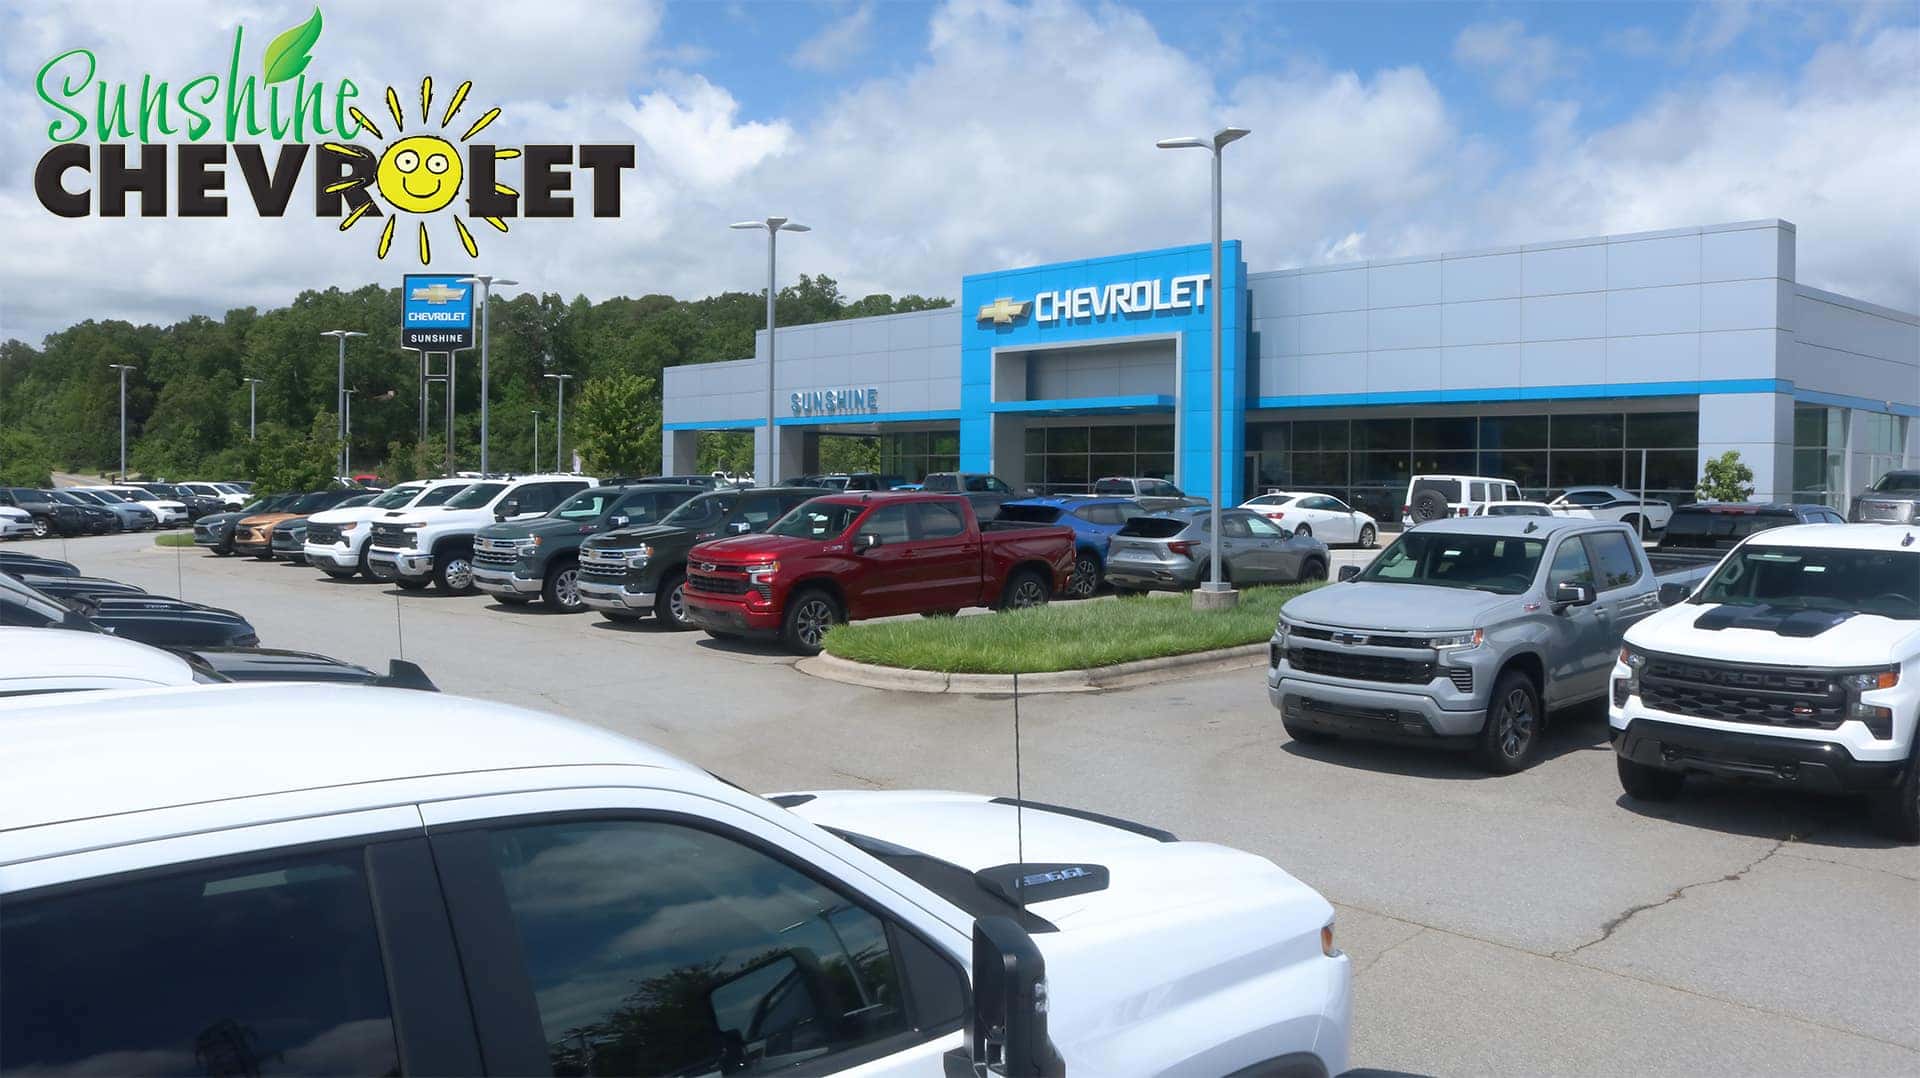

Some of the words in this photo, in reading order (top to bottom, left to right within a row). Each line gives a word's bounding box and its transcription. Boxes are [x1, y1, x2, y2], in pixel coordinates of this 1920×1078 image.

[1035, 274, 1211, 322] CHEVROLET
[408, 312, 467, 321] CHEVROLET
[410, 334, 463, 343] SUNSHINE
[791, 388, 878, 414] SUNSHINE
[1647, 662, 1826, 690] CHEVROLET
